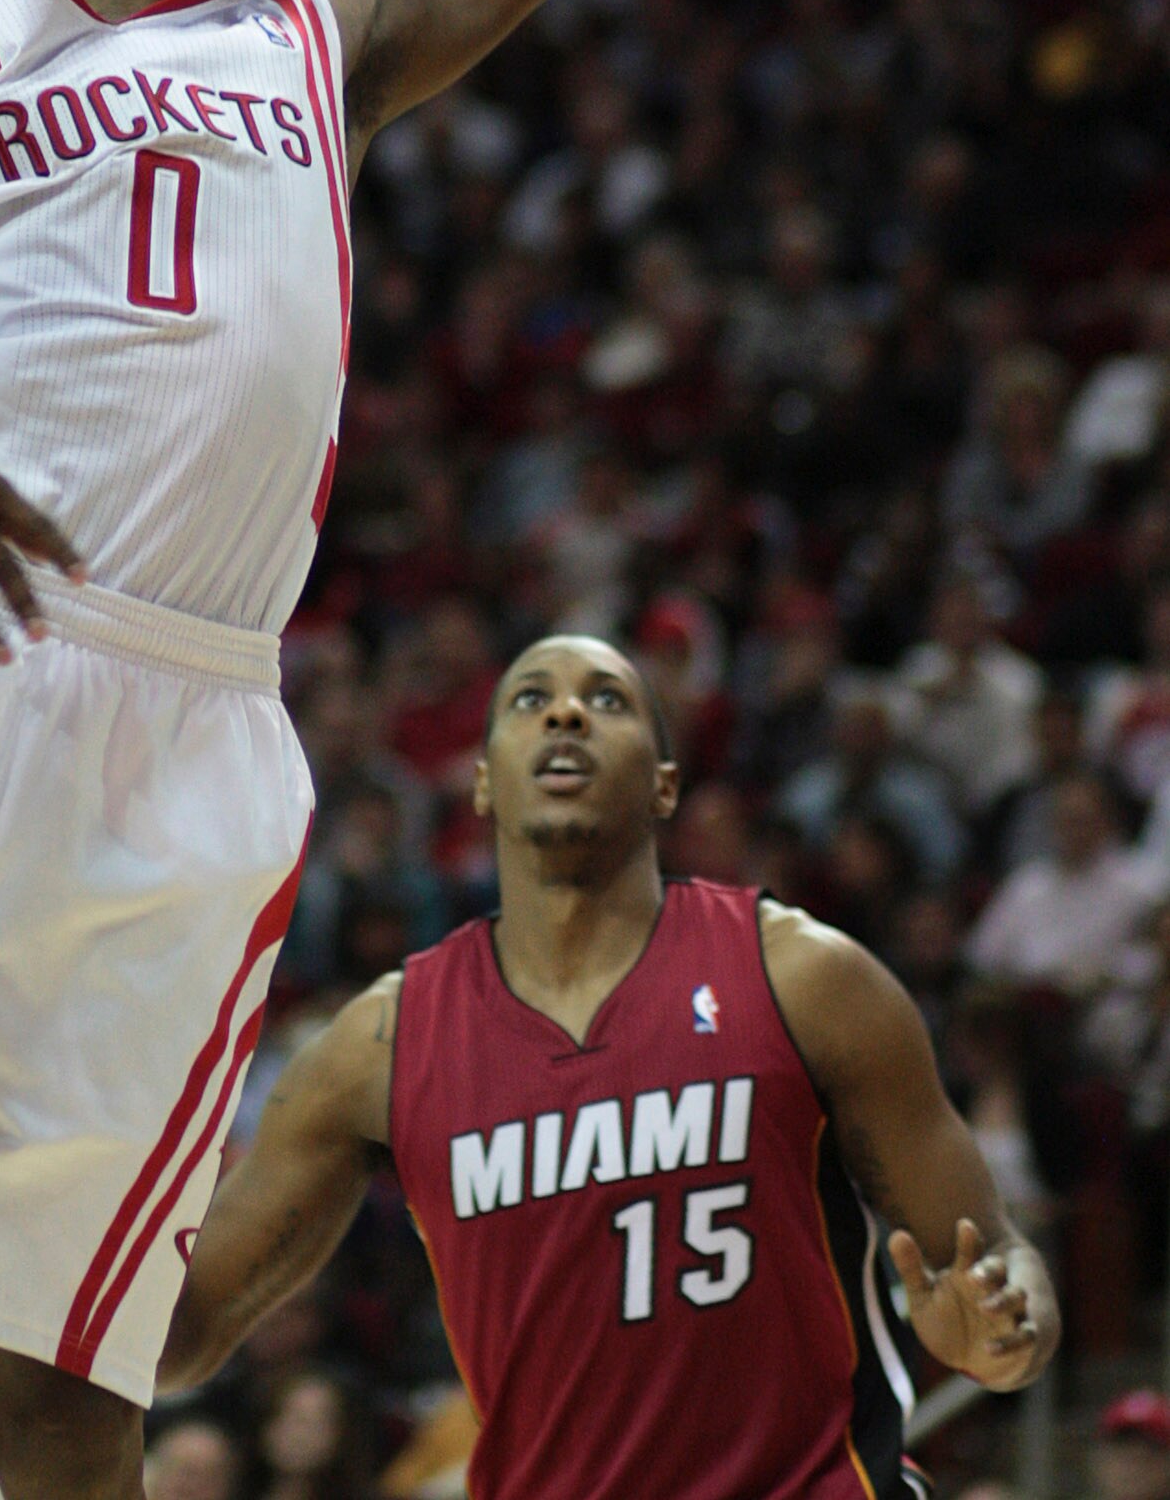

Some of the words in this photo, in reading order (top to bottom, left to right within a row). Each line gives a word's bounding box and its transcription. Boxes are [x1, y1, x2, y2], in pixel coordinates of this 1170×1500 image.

[126, 148, 202, 316] 0
[448, 1075, 755, 1221] MIAMI
[612, 1181, 754, 1323] 15
